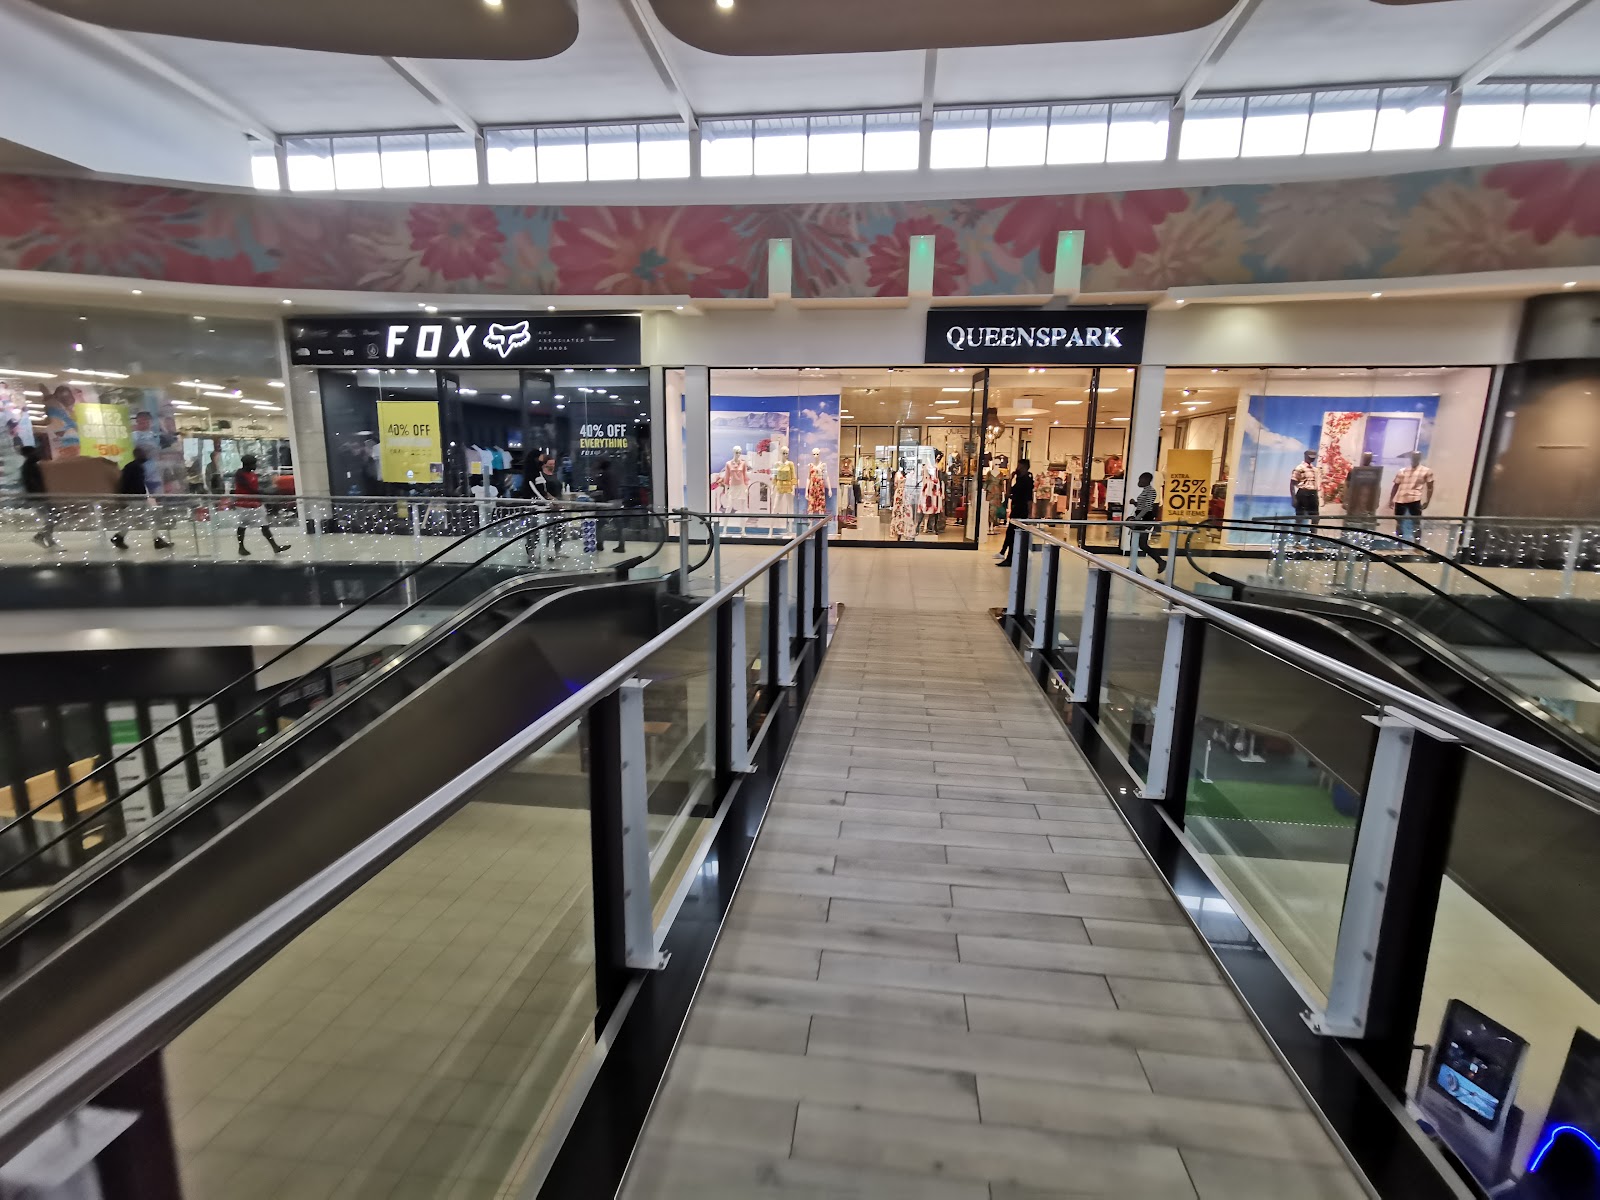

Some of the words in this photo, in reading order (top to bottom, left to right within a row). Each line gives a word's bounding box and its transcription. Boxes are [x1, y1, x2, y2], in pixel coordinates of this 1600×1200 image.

[386, 324, 477, 359] FOX
[946, 325, 1124, 351] QUEENSPARK
[388, 424, 410, 436] 40%
[413, 424, 431, 436] OFF
[579, 424, 604, 438] 40%
[607, 424, 627, 438] OFF
[580, 438, 628, 449] EVERYTHING
[1170, 479, 1207, 494] 25%
[1169, 494, 1207, 510] OFF
